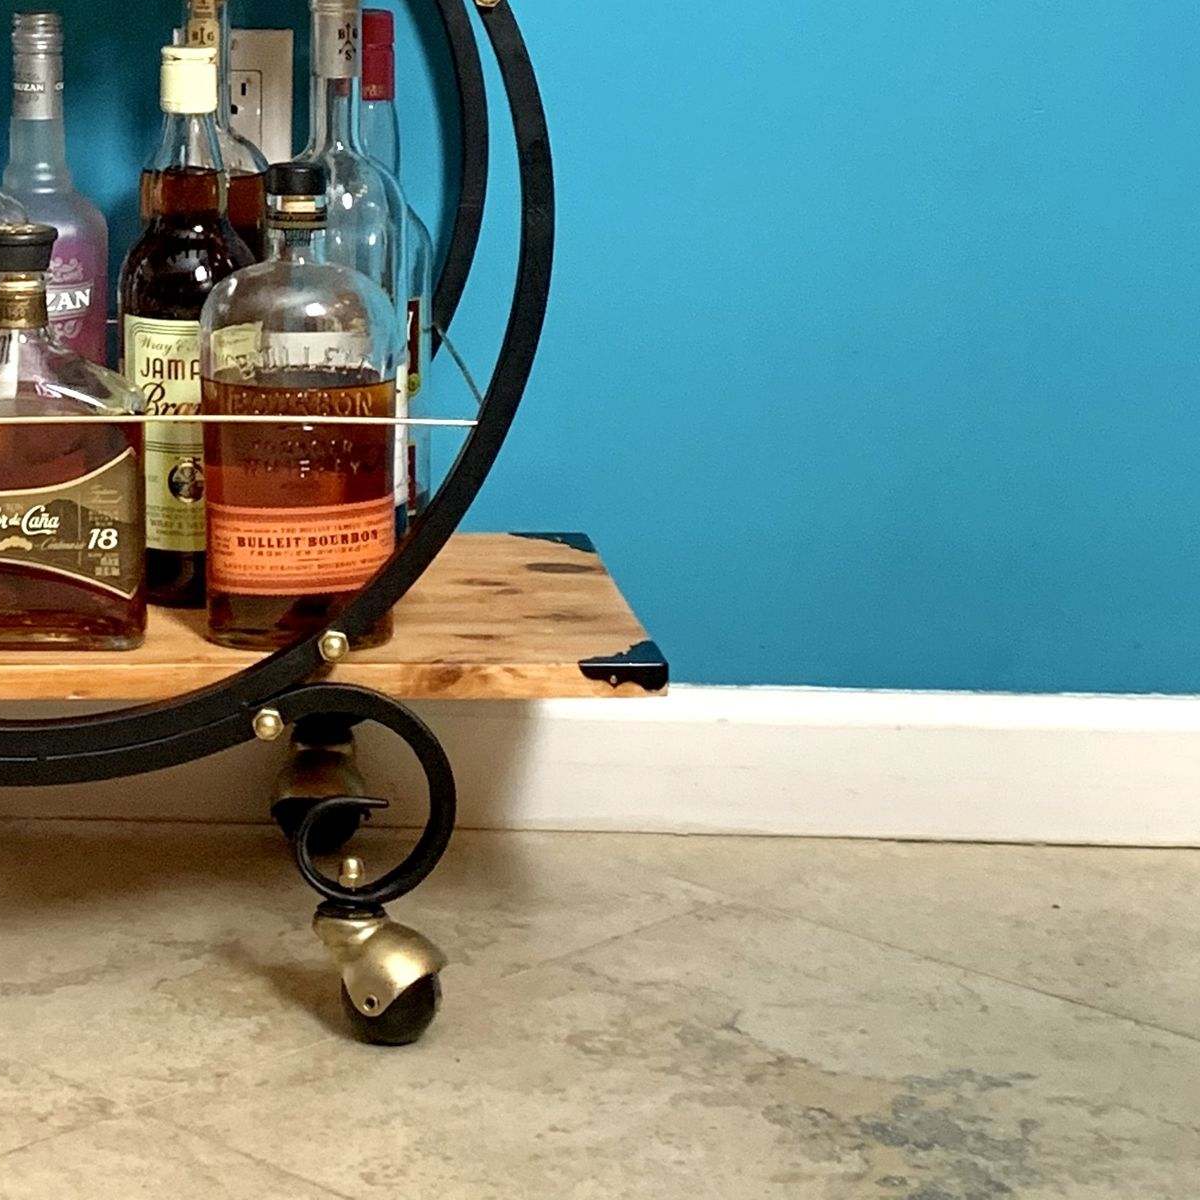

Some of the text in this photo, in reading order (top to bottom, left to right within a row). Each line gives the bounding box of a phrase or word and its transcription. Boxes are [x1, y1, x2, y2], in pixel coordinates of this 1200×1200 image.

[139, 357, 200, 381] JAMA
[9, 512, 22, 526] de
[21, 504, 61, 536] Caña
[87, 527, 119, 550] 18
[237, 535, 302, 549] BULLEIT
[308, 529, 378, 548] BOURBON
